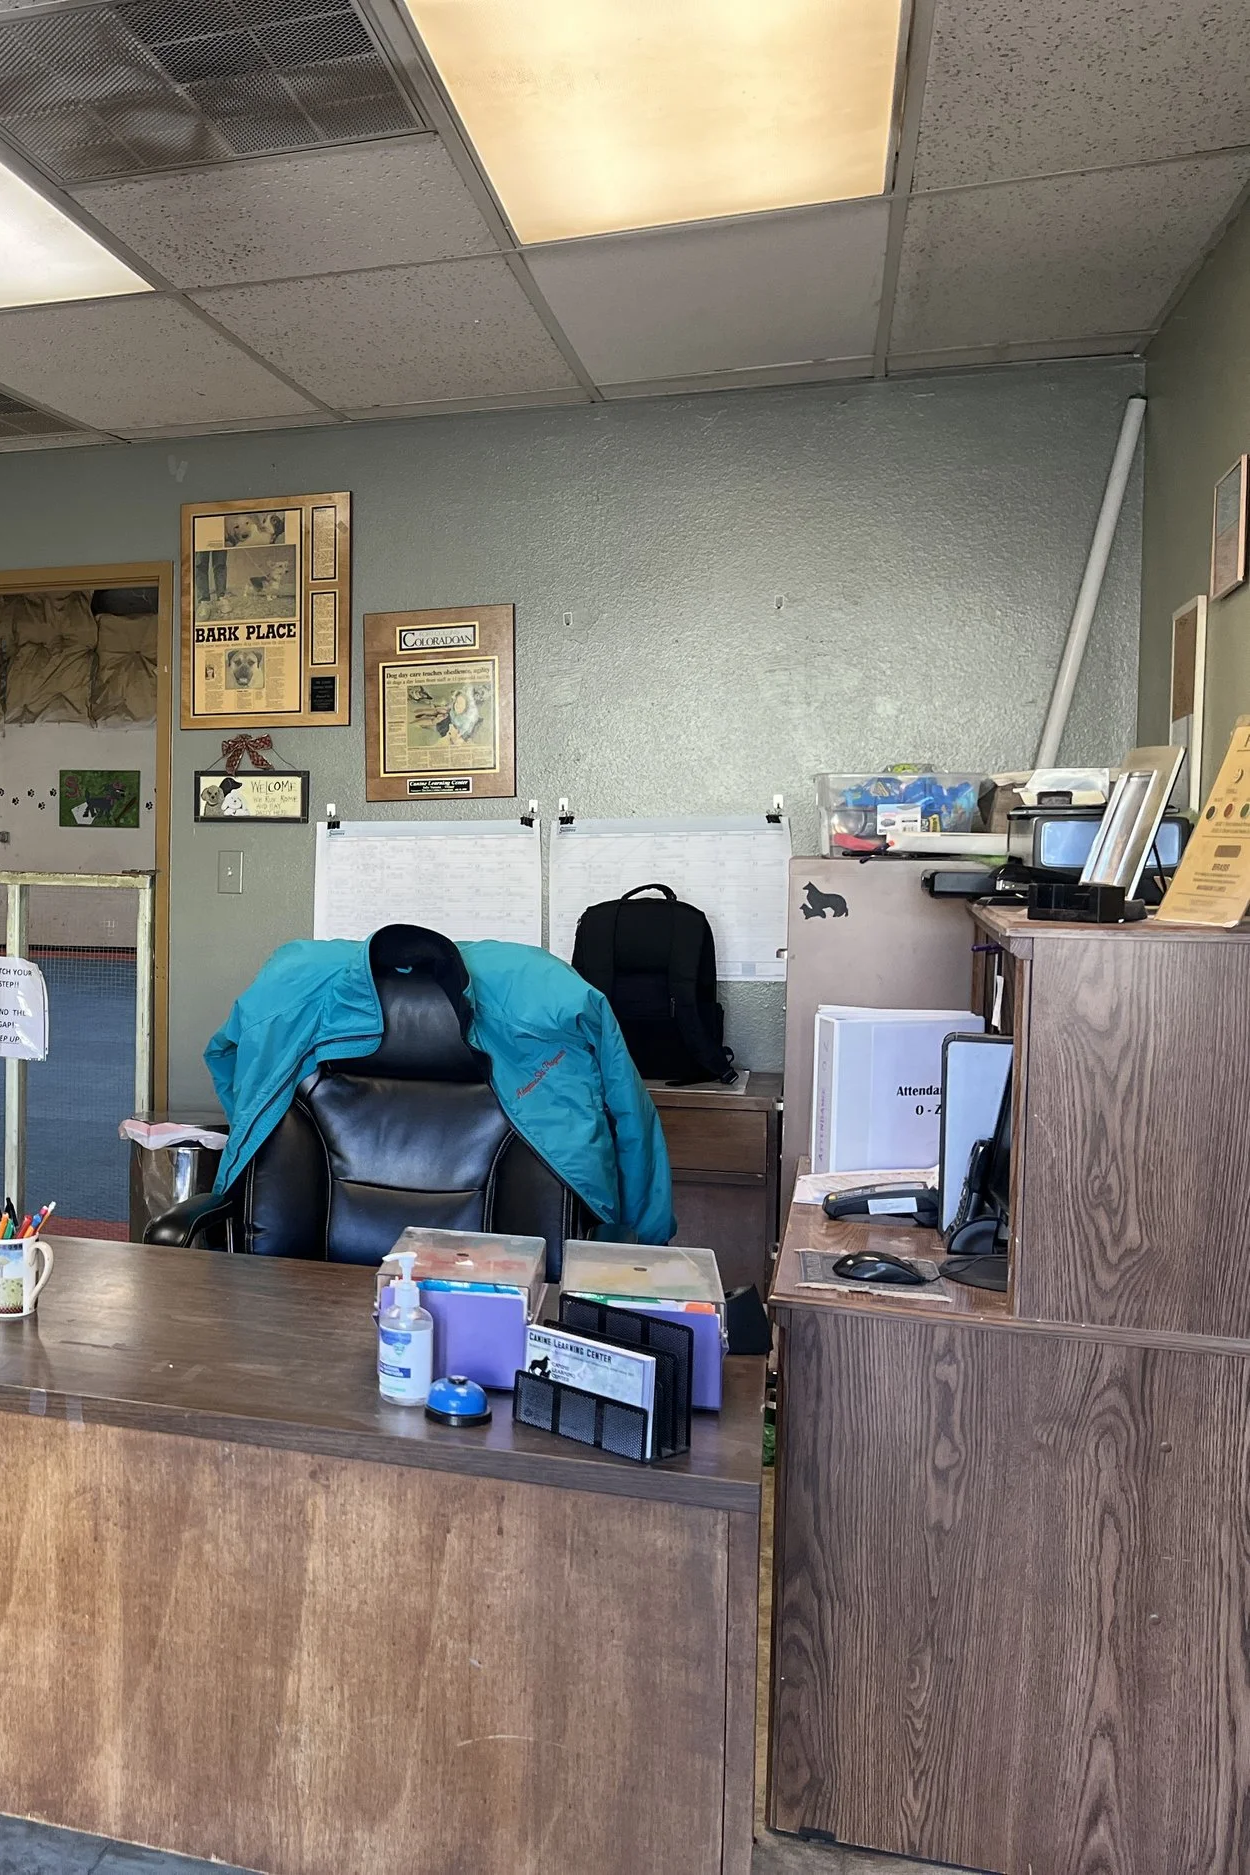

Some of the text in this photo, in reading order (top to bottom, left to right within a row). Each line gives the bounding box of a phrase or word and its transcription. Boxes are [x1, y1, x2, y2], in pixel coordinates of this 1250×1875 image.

[195, 623, 296, 643] BARK PLACE
[403, 632, 472, 647] COLORADOAN
[250, 780, 297, 795] WELCOME
[896, 1085, 942, 1096] Attenda
[530, 1332, 551, 1346] CANINE
[553, 1339, 584, 1355] LEARNING
[586, 1349, 612, 1363] CENTER
